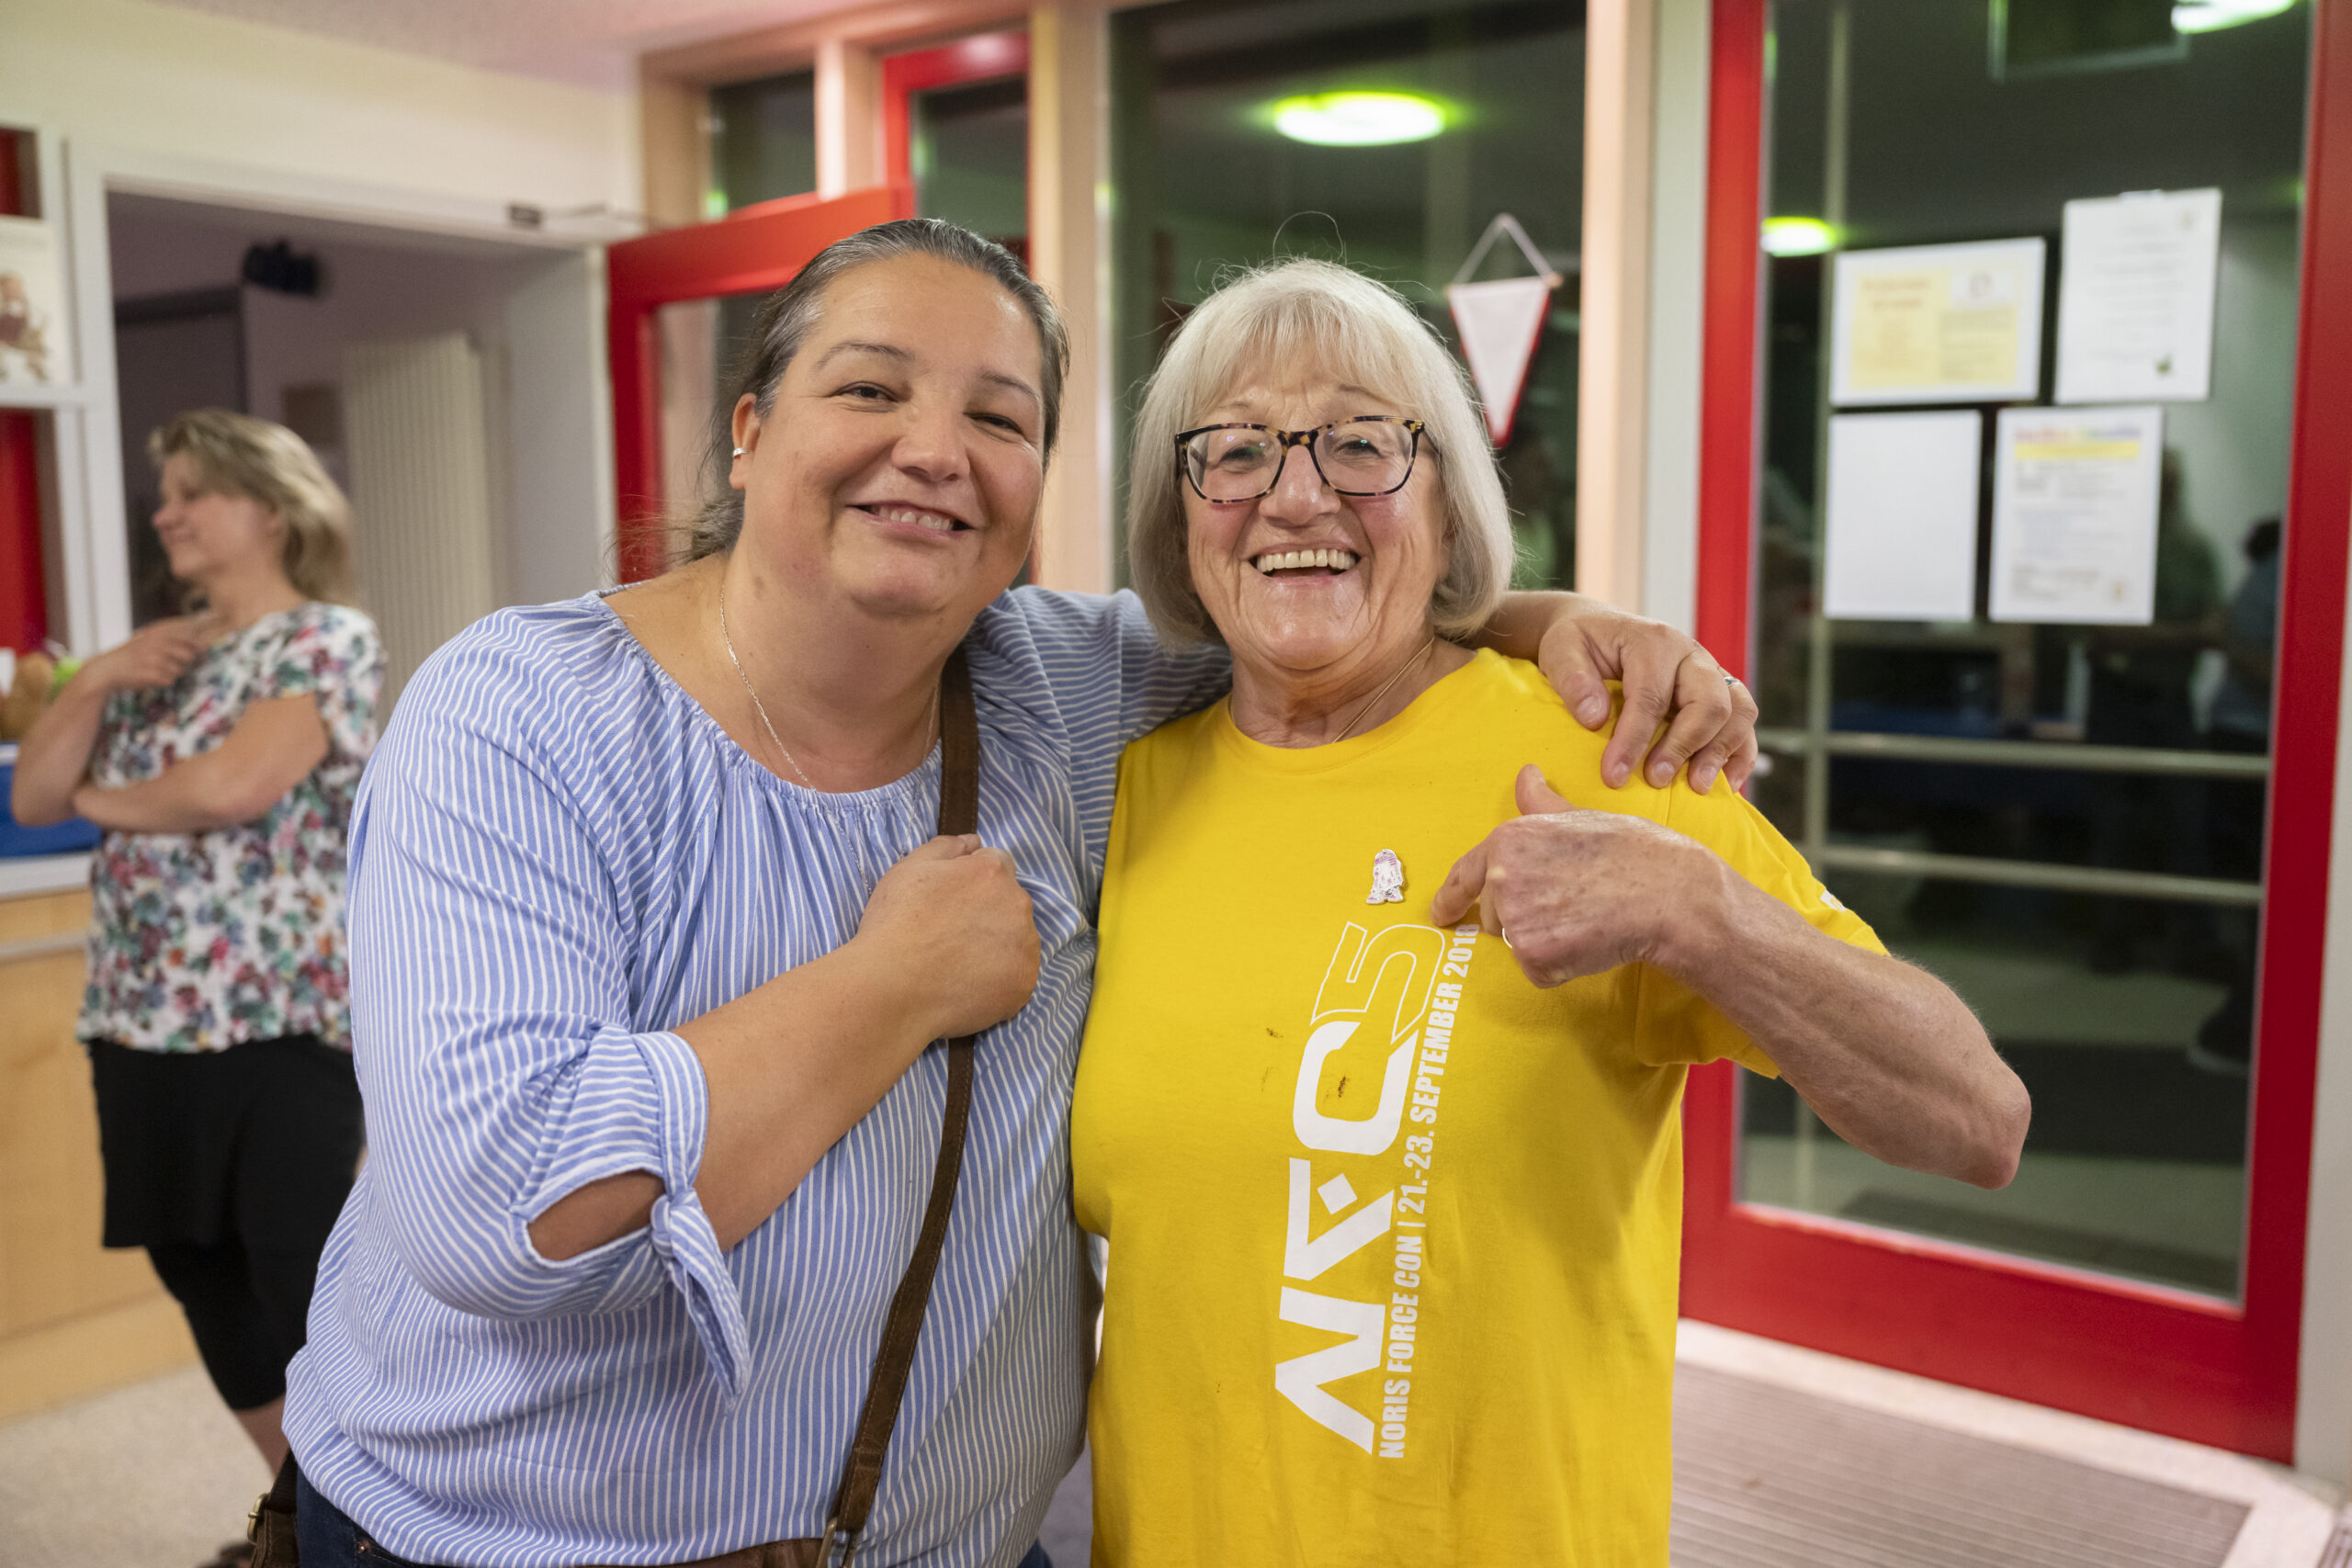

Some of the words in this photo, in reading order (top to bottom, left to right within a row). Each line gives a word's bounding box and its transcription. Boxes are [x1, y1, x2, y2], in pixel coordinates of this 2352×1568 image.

[1442, 924, 1480, 978] 2018
[1409, 982, 1464, 1124] SEPTEMBER
[1397, 1131, 1435, 1215] 21.-23.
[1393, 1235, 1423, 1289] CON
[1386, 1292, 1419, 1373] FORCE
[1379, 1379, 1411, 1459] NORIS
